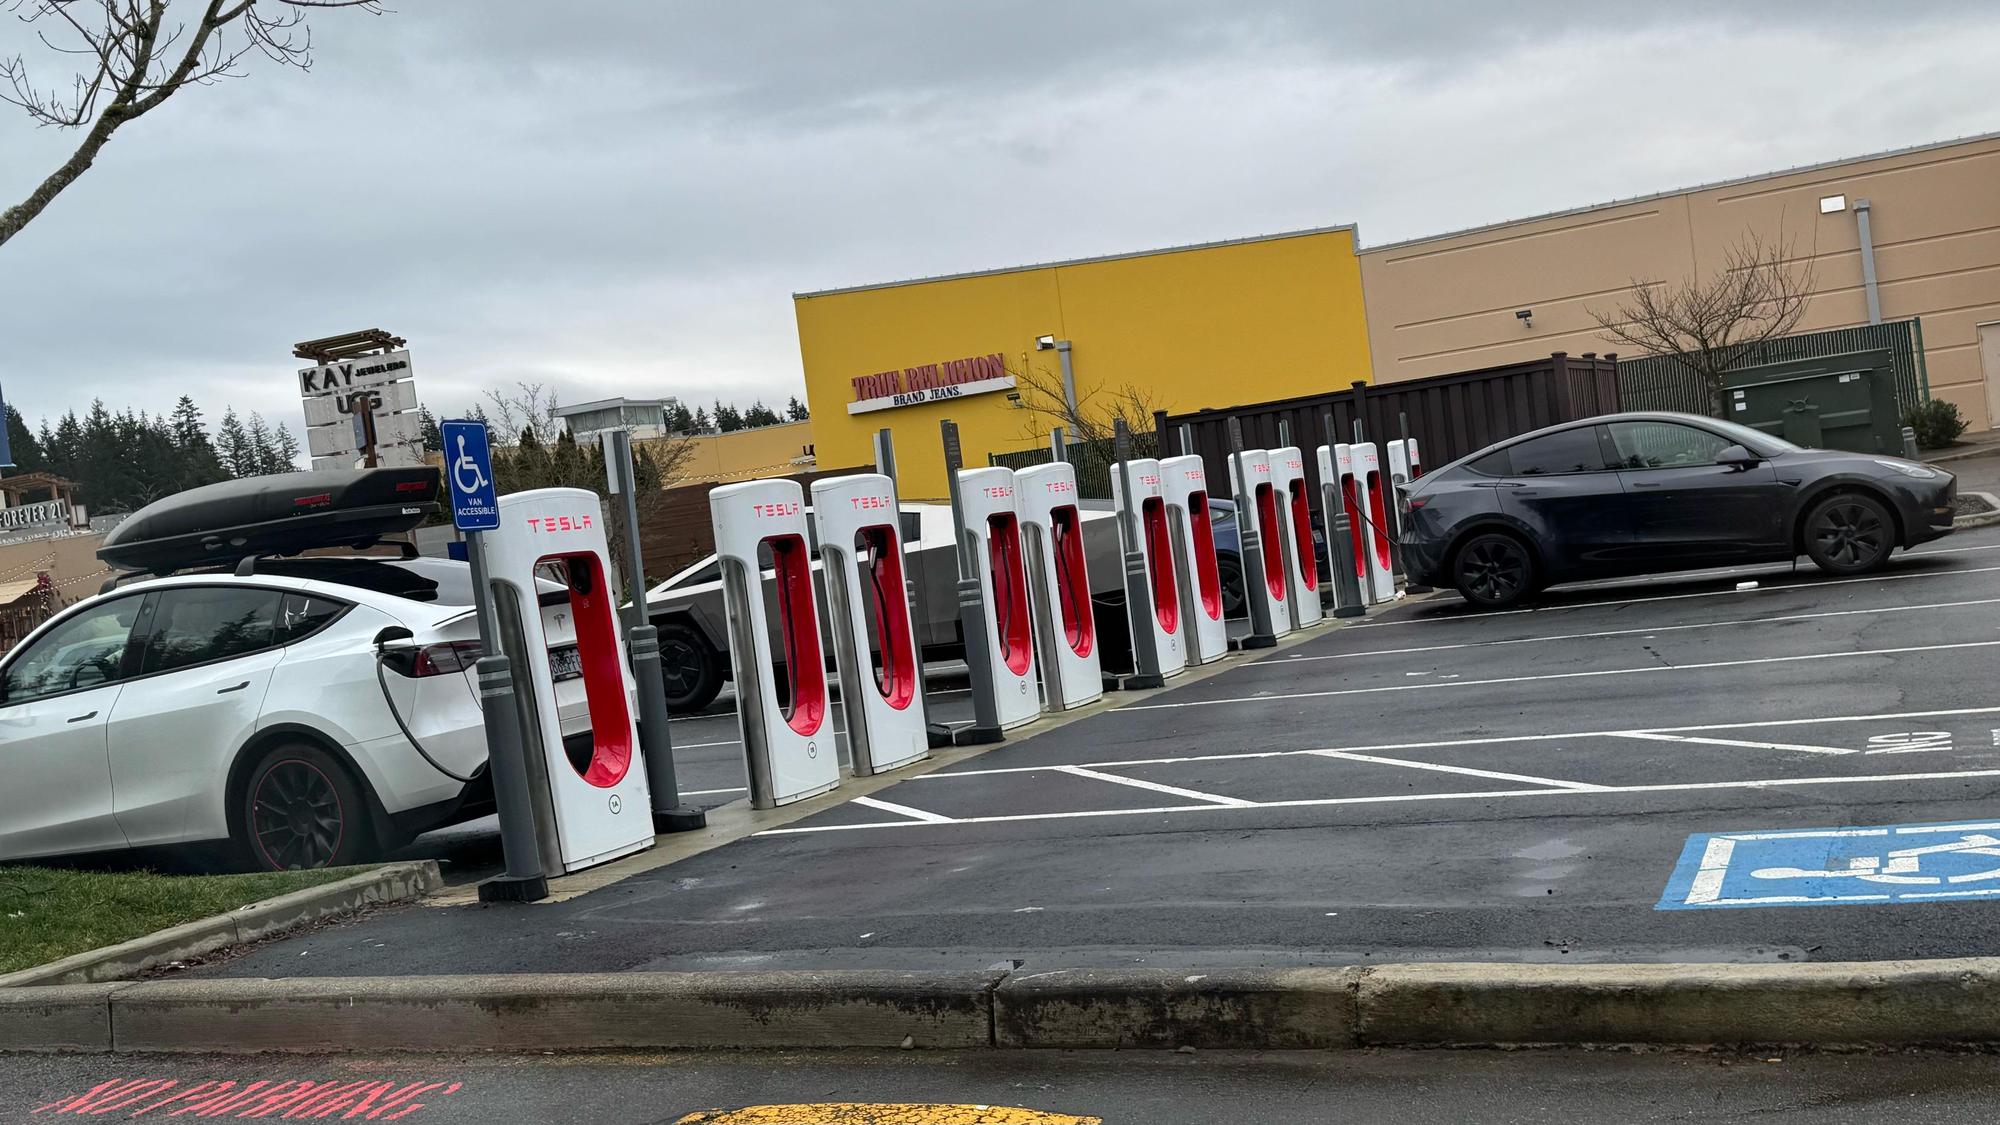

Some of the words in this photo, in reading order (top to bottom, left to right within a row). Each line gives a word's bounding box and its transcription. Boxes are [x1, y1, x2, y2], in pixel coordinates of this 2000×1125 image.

[302, 364, 353, 392] KAY
[851, 370, 900, 401] TRUE
[904, 353, 1005, 393] RELIGION
[894, 391, 925, 405] BRAND
[468, 498, 483, 506] VAN
[851, 496, 891, 510] TESLA
[50, 502, 62, 519] 21
[458, 506, 495, 516] ACCESSIBLE
[753, 503, 799, 518] TESLA
[527, 515, 592, 533] TESLA
